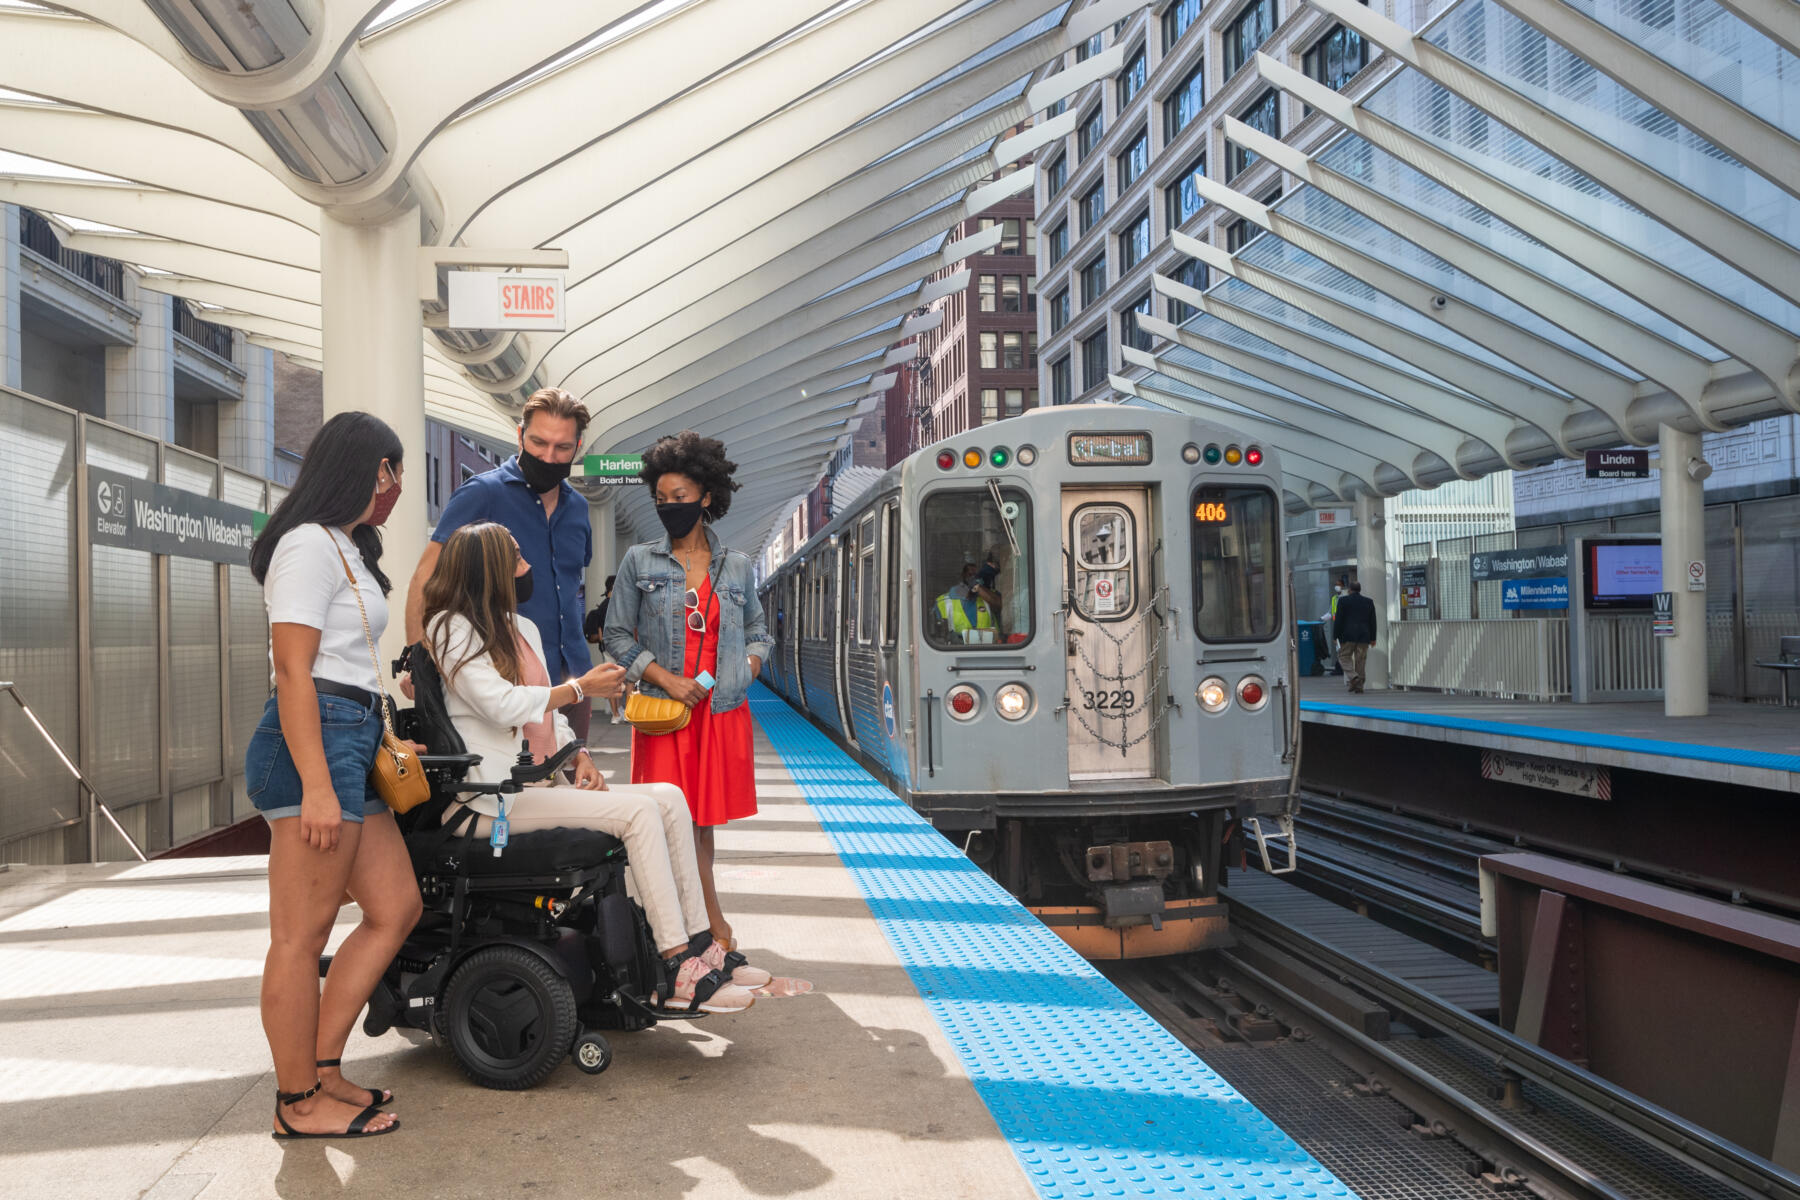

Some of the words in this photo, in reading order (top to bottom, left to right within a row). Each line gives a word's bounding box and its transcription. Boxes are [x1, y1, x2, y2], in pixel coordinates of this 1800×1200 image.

[503, 285, 554, 310] STAIRS
[600, 459, 643, 470] Harlem
[1600, 454, 1636, 465] Linden
[600, 476, 624, 484] Board
[625, 476, 643, 484] here
[1195, 503, 1227, 521] 406
[97, 517, 127, 537] Elevator
[134, 499, 242, 548] Washington/Wabash
[1552, 584, 1568, 595] Park
[1656, 593, 1670, 611] W
[1083, 690, 1135, 710] 3229
[1504, 758, 1526, 769] Danger
[1530, 762, 1546, 773] Keep
[1557, 765, 1578, 777] Tracks
[1522, 771, 1536, 783] High
[1536, 772, 1560, 787] Voltage
